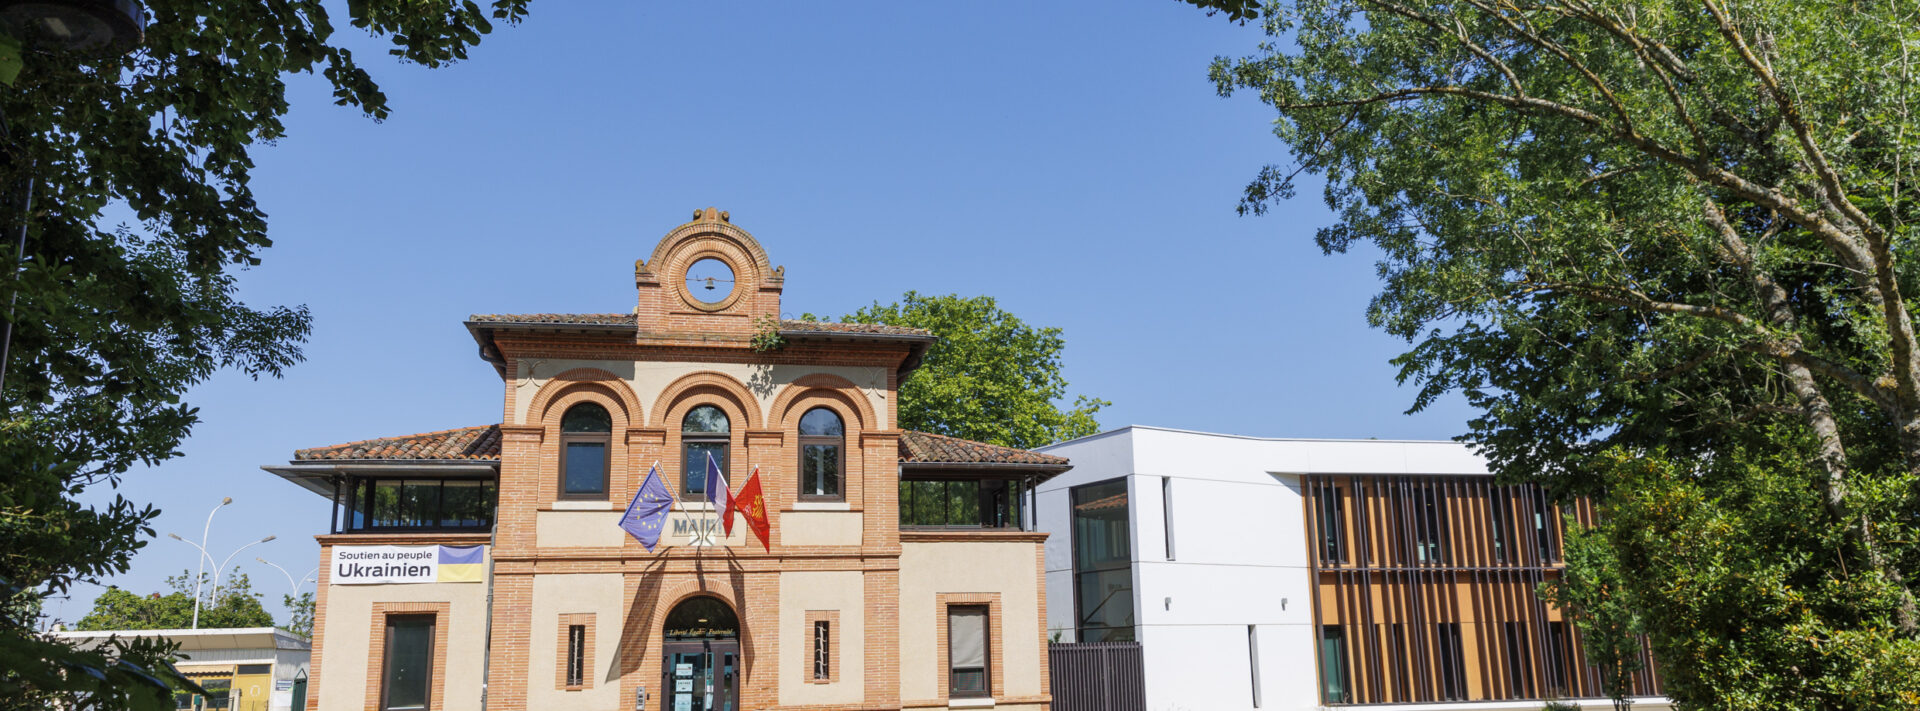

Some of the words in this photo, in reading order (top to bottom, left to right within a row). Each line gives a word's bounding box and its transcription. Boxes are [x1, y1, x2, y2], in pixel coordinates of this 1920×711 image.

[339, 551, 380, 560] Soutien
[382, 552, 395, 560] au
[397, 551, 433, 561] peuple
[338, 562, 431, 578] Ukrainien
